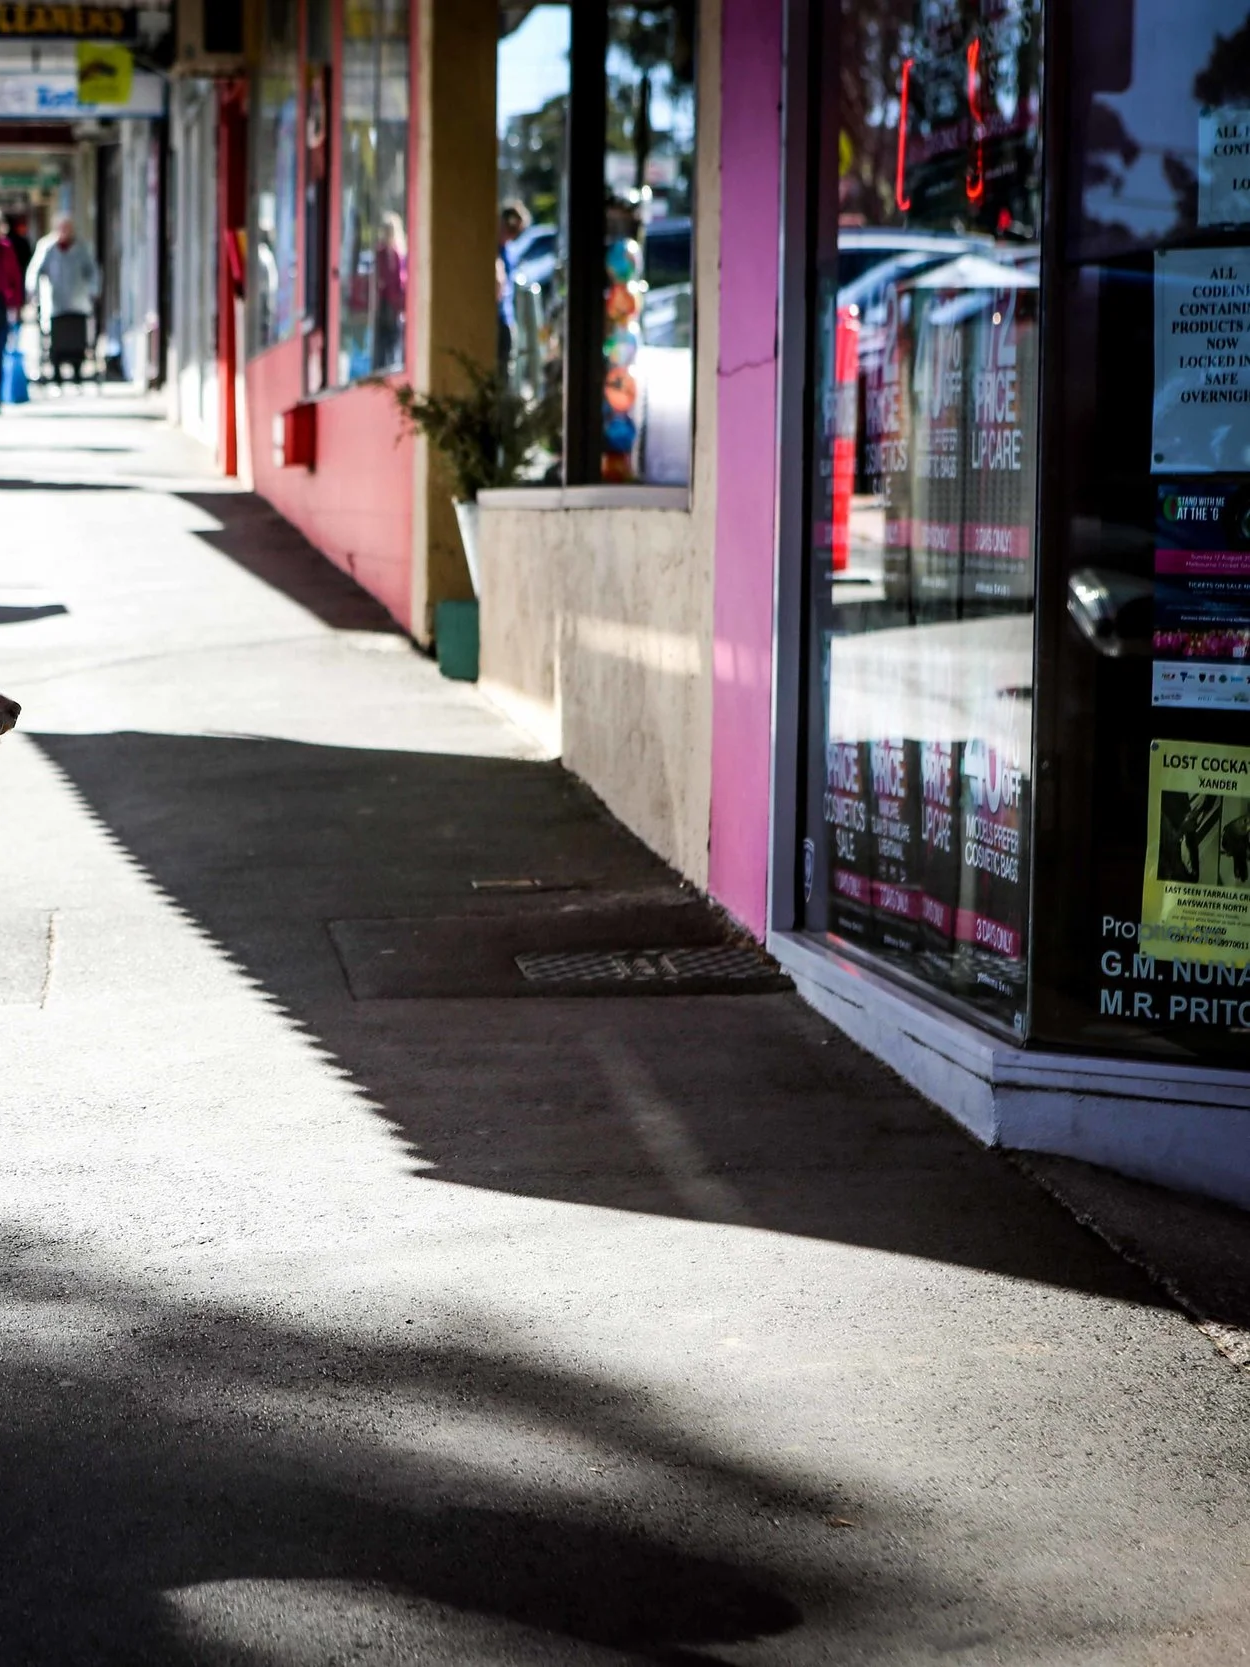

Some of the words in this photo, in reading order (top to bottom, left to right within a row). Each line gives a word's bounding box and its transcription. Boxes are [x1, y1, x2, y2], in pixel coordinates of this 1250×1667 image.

[1214, 125, 1241, 140] ALL
[1209, 266, 1238, 280] ALL
[1172, 319, 1244, 334] PRODUCTS
[1206, 337, 1239, 350] NOW
[1179, 355, 1235, 369] LOCKED
[1205, 372, 1238, 386] SAFE
[975, 371, 1018, 424] PRICE
[1198, 496, 1215, 507] WITH
[1177, 507, 1188, 520] AT
[1190, 507, 1207, 521] THE
[1163, 754, 1198, 770] LOST
[1201, 757, 1250, 774] COCKA
[1002, 767, 1022, 808] OFF
[1198, 777, 1238, 791] XANDER
[993, 823, 1019, 855] PREFER
[1000, 850, 1019, 884] BAGS
[1165, 886, 1182, 895] LAST
[1183, 887, 1202, 897] SEEN
[1239, 893, 1250, 902] CR
[1177, 898, 1221, 910] BAYSWATER
[1222, 902, 1248, 913] NORTH
[1100, 950, 1163, 981] G.M.
[1172, 957, 1250, 986] NUNA
[1100, 988, 1161, 1019] M.R.
